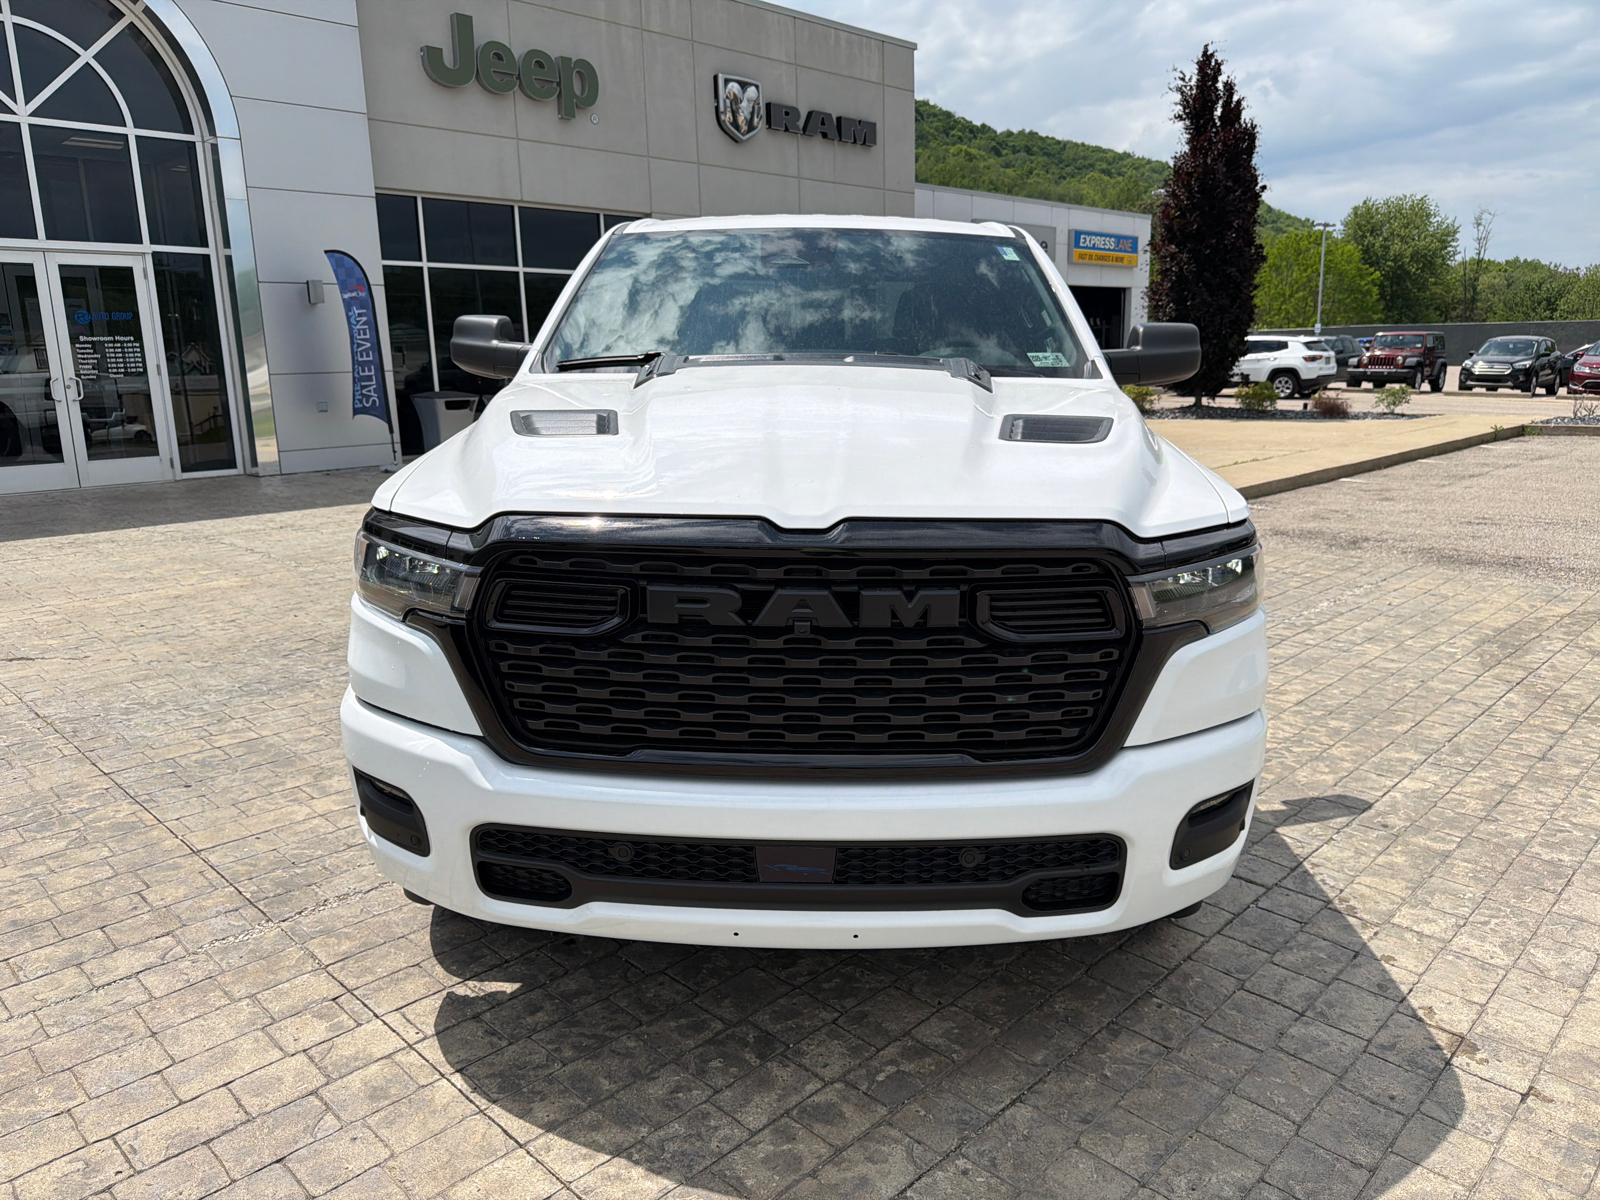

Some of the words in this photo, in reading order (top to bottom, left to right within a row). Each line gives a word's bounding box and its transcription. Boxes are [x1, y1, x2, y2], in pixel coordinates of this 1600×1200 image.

[420, 12, 599, 120] Jeep
[765, 102, 877, 147] RAM
[92, 312, 110, 320] AUTO
[112, 312, 133, 320] GROUP
[353, 306, 373, 361] EVENT
[359, 365, 379, 407] SALE
[647, 585, 961, 628] RAM
